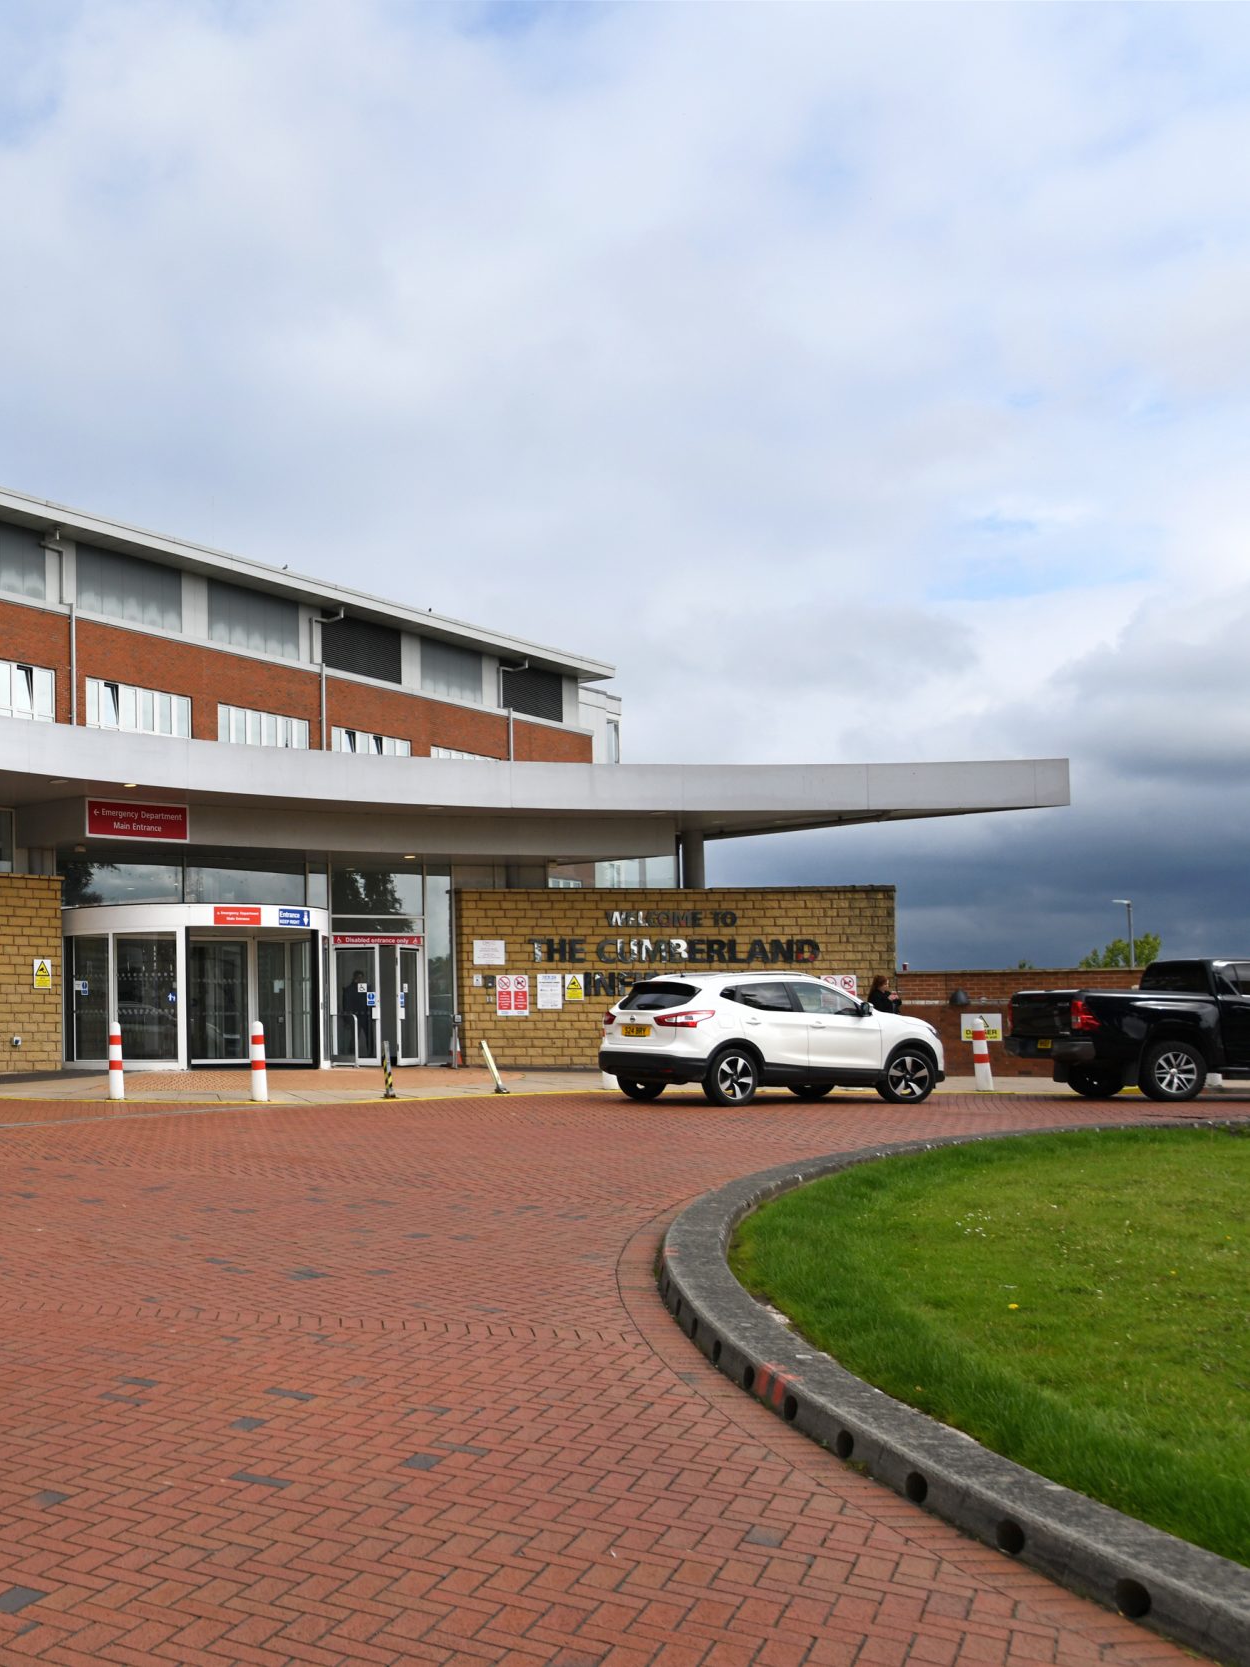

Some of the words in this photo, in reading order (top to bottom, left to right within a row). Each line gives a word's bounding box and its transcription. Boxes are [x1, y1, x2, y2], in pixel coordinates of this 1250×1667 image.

[101, 808, 138, 819] Emergency
[141, 811, 182, 821] Department
[113, 822, 130, 830] Main
[132, 823, 162, 832] Entrance
[606, 911, 702, 927] WELCOME
[712, 911, 737, 927] TO
[528, 938, 586, 963] THE
[596, 938, 820, 963] CUMBERLAND
